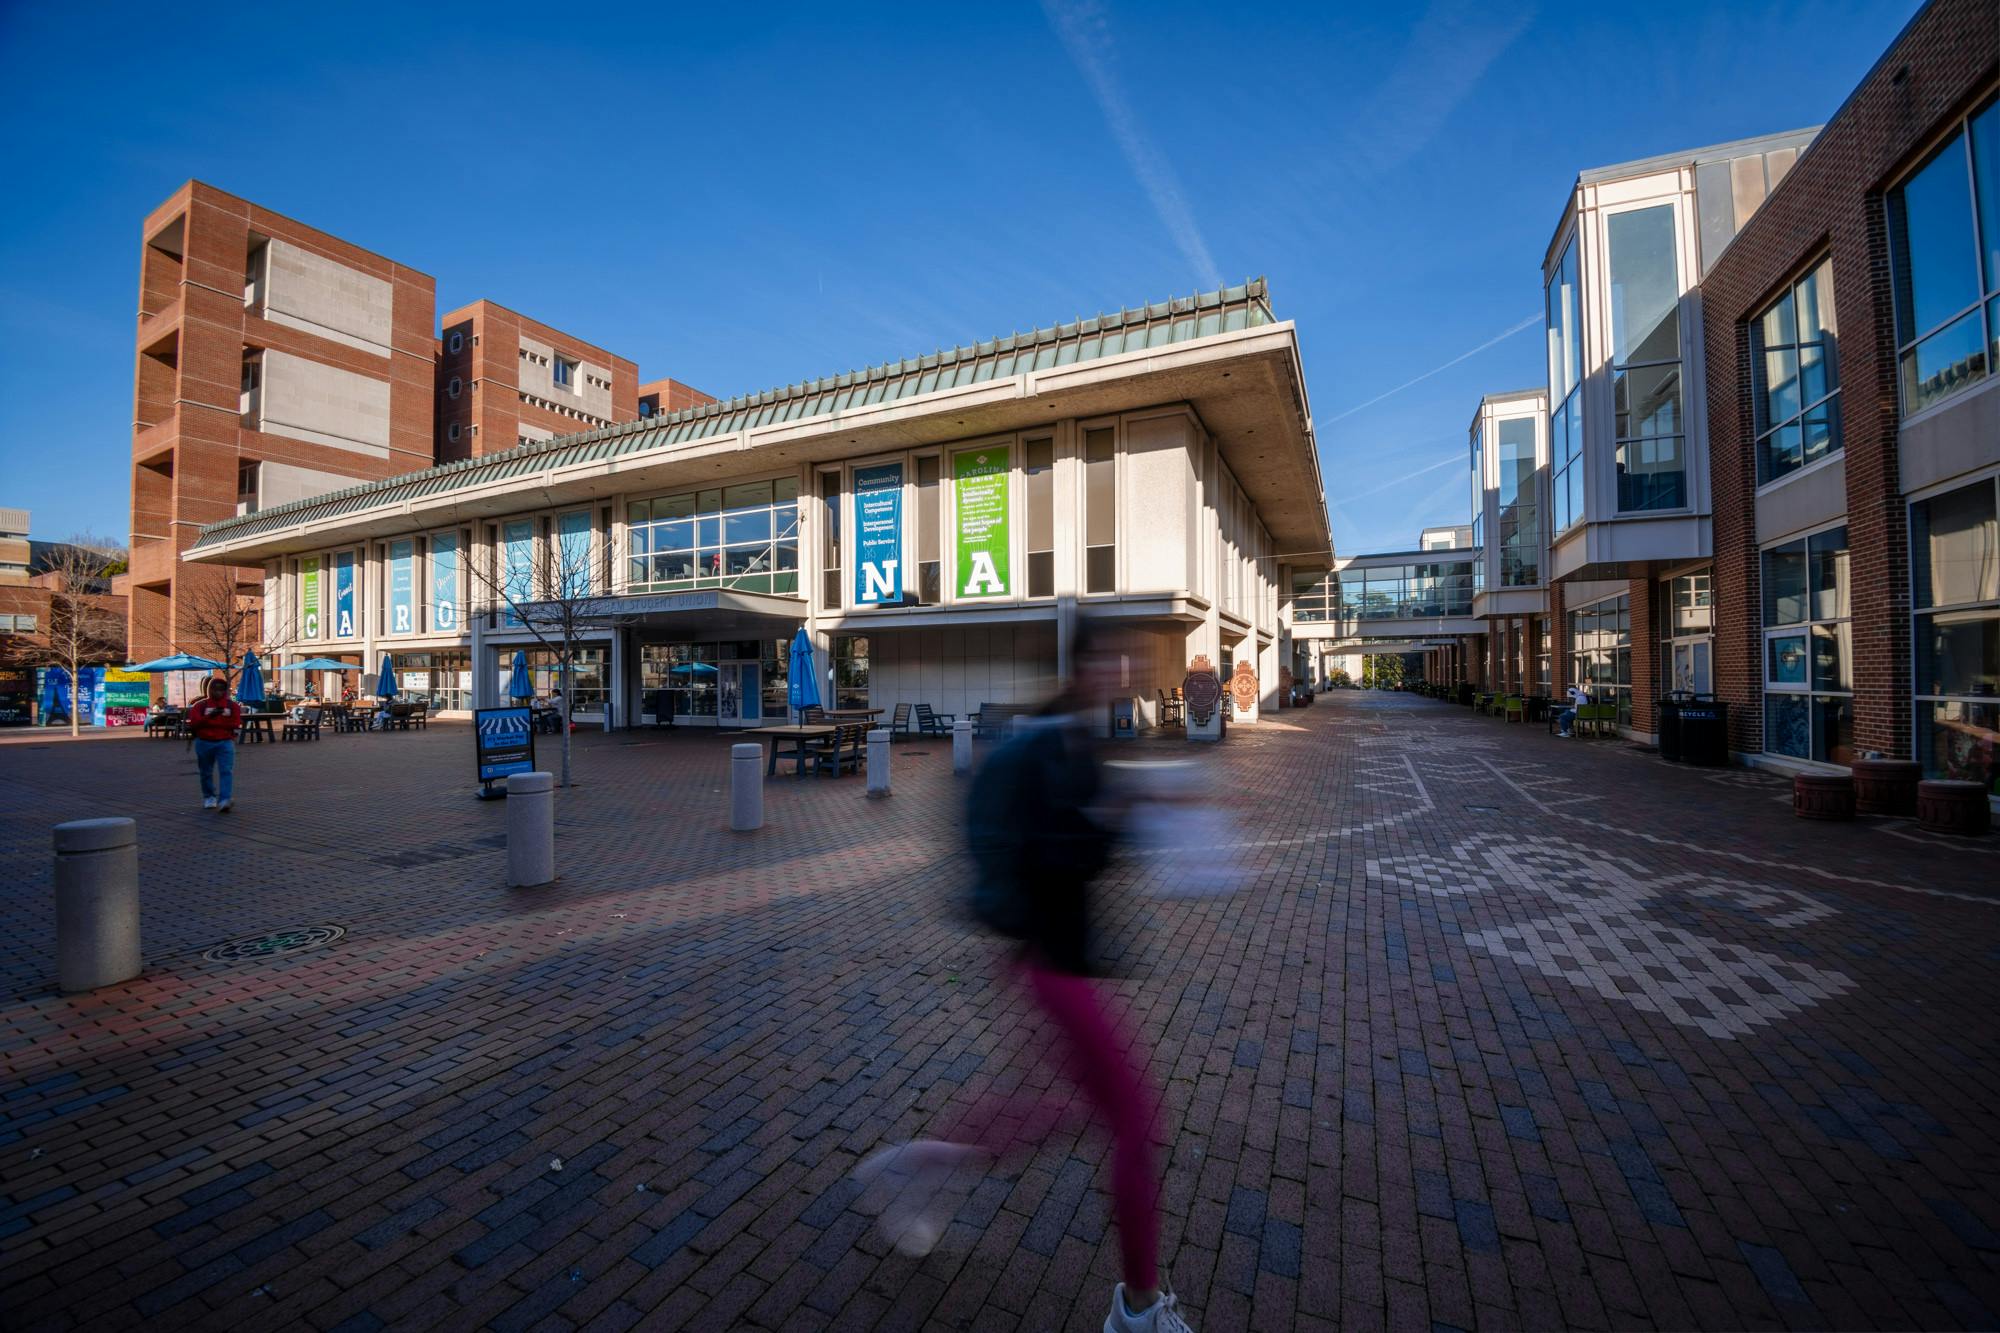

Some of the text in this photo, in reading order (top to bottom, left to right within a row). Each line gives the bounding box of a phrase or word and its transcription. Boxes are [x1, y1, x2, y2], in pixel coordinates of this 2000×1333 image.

[858, 474, 900, 487] Community
[863, 499, 893, 509] Intercultural
[864, 506, 893, 515] Competence
[863, 517, 894, 528] Interpersonal
[863, 525, 895, 533] Development
[862, 539, 877, 547] Public
[862, 559, 898, 600] N
[963, 551, 1004, 595] A
[629, 597, 673, 611] STUDENT
[679, 595, 711, 608] UNION
[395, 604, 410, 631] R
[438, 600, 453, 628] O
[306, 613, 317, 637] C
[339, 610, 353, 635] A
